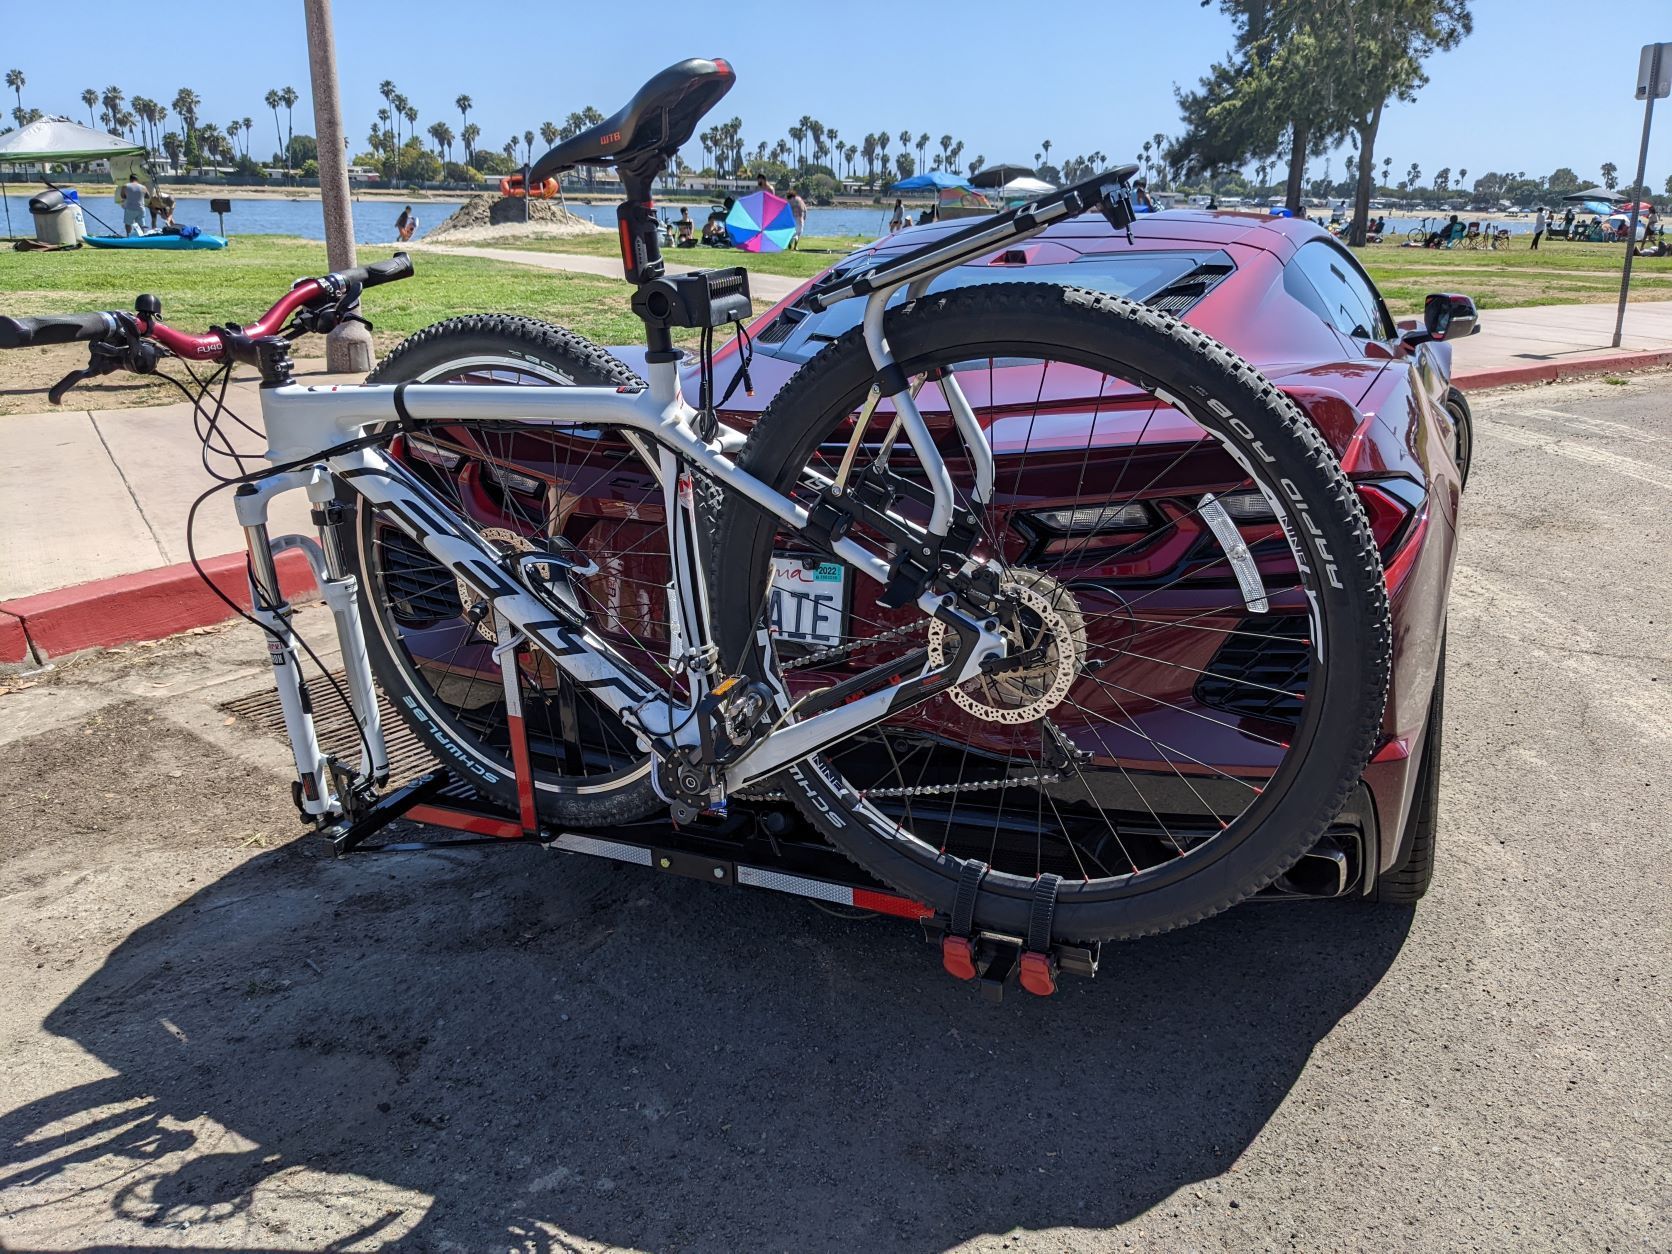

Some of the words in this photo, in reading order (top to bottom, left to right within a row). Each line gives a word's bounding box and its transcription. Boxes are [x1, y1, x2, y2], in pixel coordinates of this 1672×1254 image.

[1205, 398, 1277, 464] ROB
[1280, 477, 1344, 590] RAPID
[1280, 516, 1308, 566] NINE
[818, 566, 837, 575] 2022
[769, 590, 834, 641] AIE
[402, 695, 500, 784] SCHWALBE
[811, 755, 843, 792] NINE
